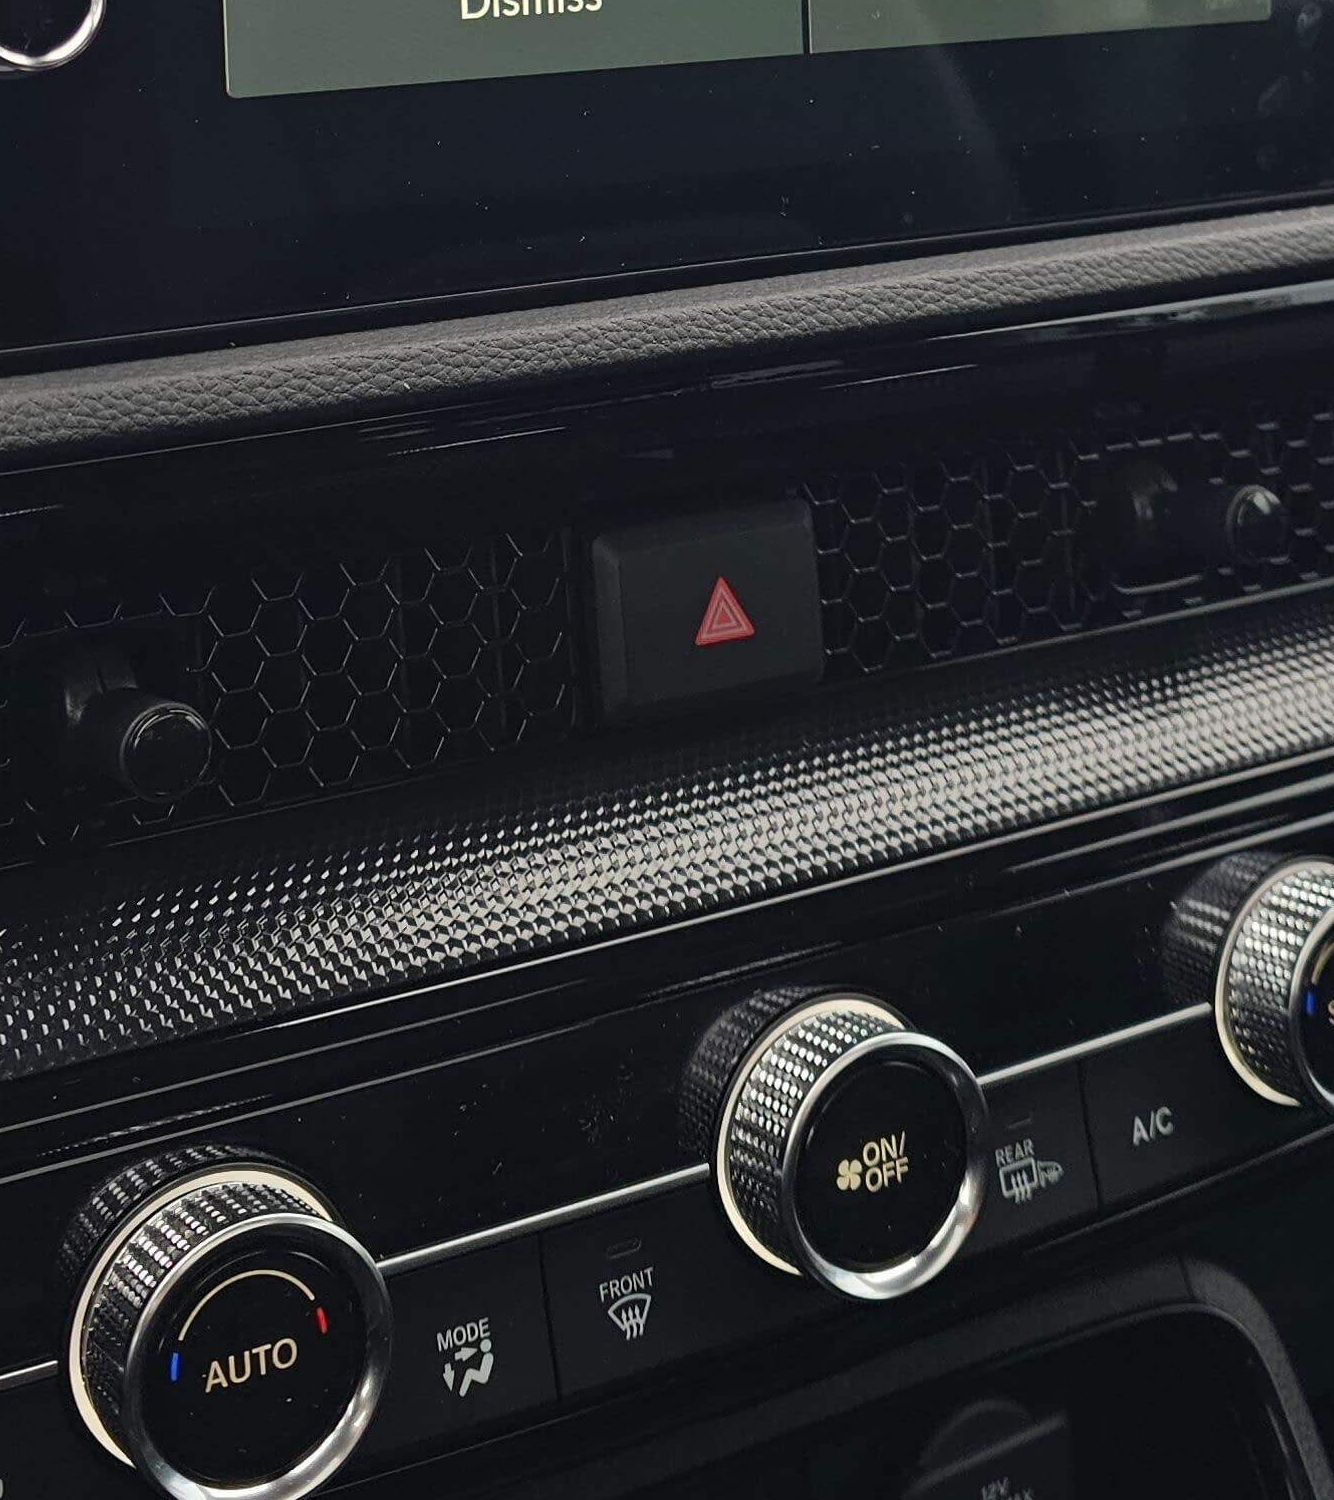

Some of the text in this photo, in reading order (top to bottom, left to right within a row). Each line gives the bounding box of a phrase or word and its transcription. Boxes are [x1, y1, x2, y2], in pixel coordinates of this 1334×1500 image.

[1132, 1106, 1173, 1145] A/C
[862, 1131, 906, 1166] ON/
[995, 1139, 1034, 1167] REAR
[864, 1159, 909, 1192] OFF
[599, 1266, 653, 1303] FRONT
[436, 1317, 491, 1352] MODE
[205, 1338, 298, 1393] AUTO
